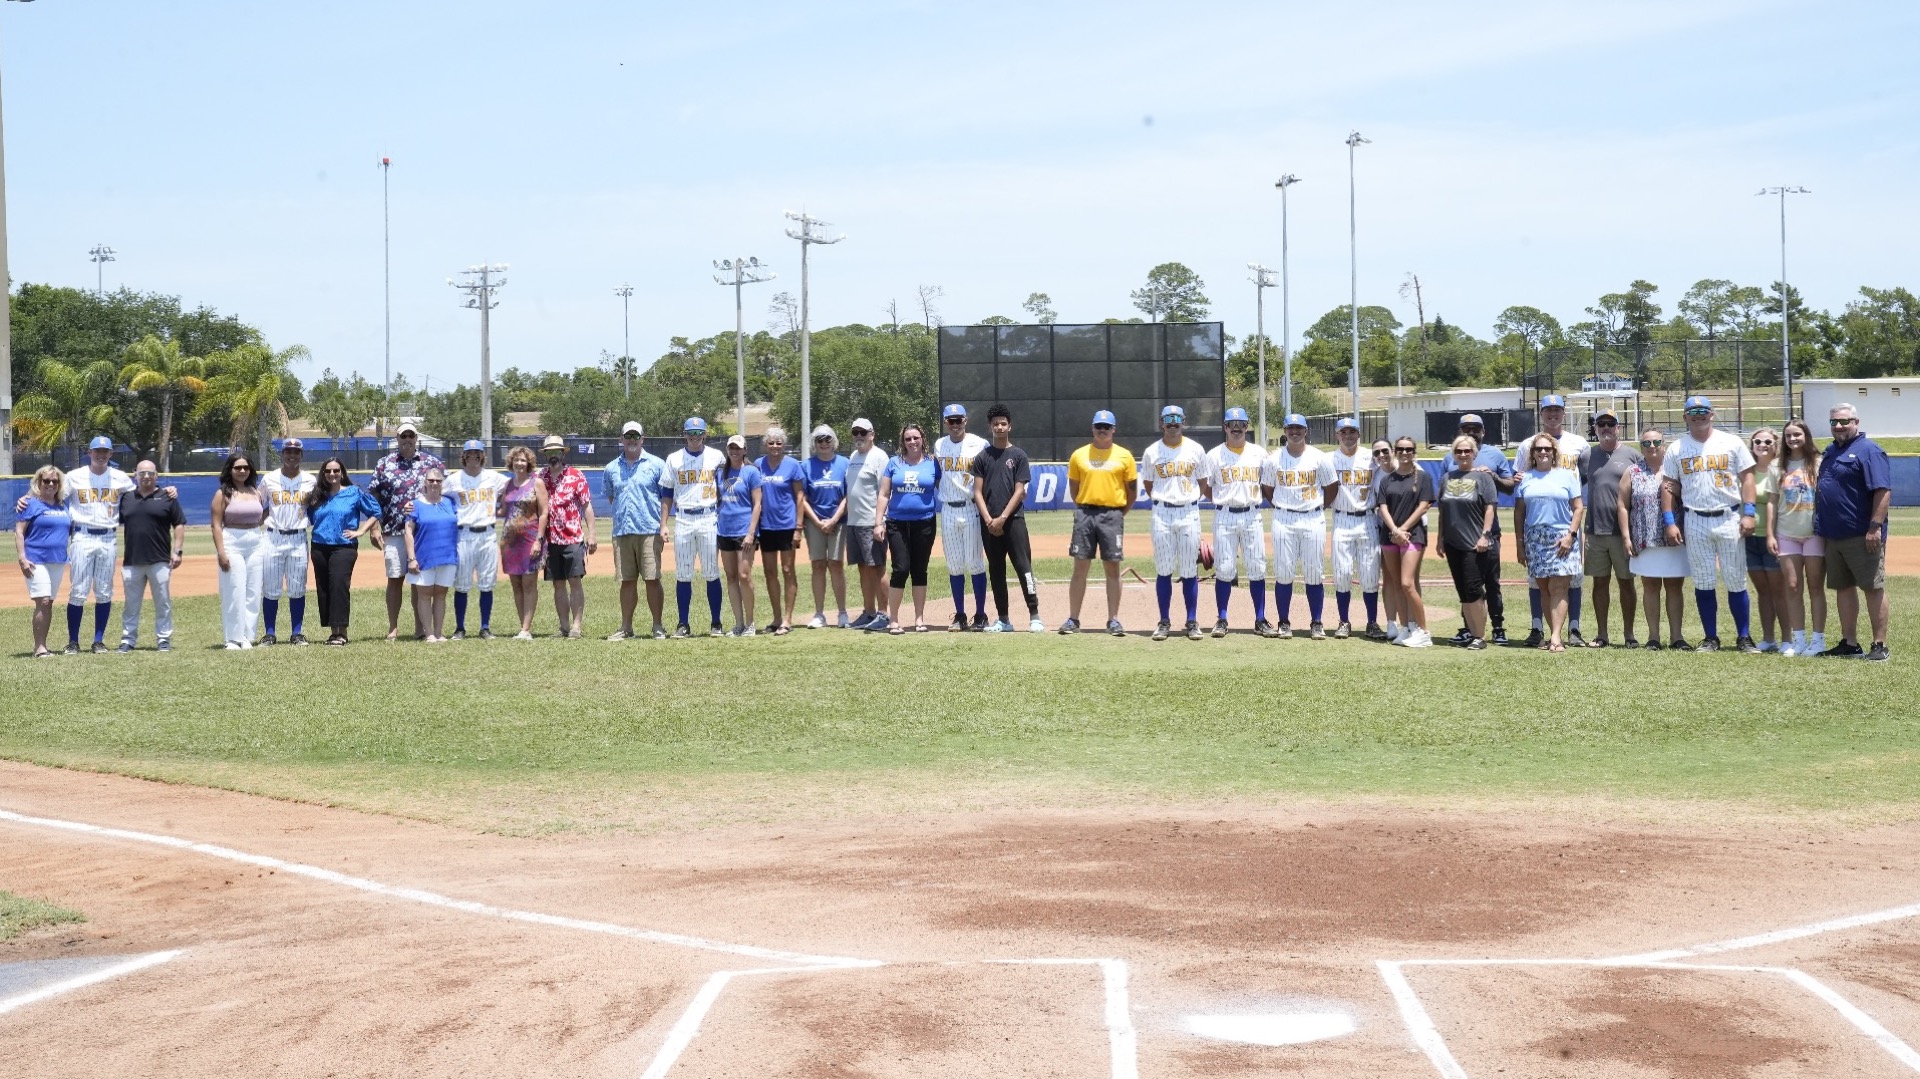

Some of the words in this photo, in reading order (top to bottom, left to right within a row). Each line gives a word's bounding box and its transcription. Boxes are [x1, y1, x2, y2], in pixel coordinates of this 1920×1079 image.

[1155, 461, 1195, 478] ERAU
[1680, 453, 1729, 475] ERAU
[678, 469, 716, 485] ERAU
[1221, 466, 1260, 484] ERAU
[1276, 470, 1316, 486] ERAU
[1714, 472, 1732, 487] 23
[78, 488, 119, 504] ERAU
[458, 487, 494, 506] ERAU
